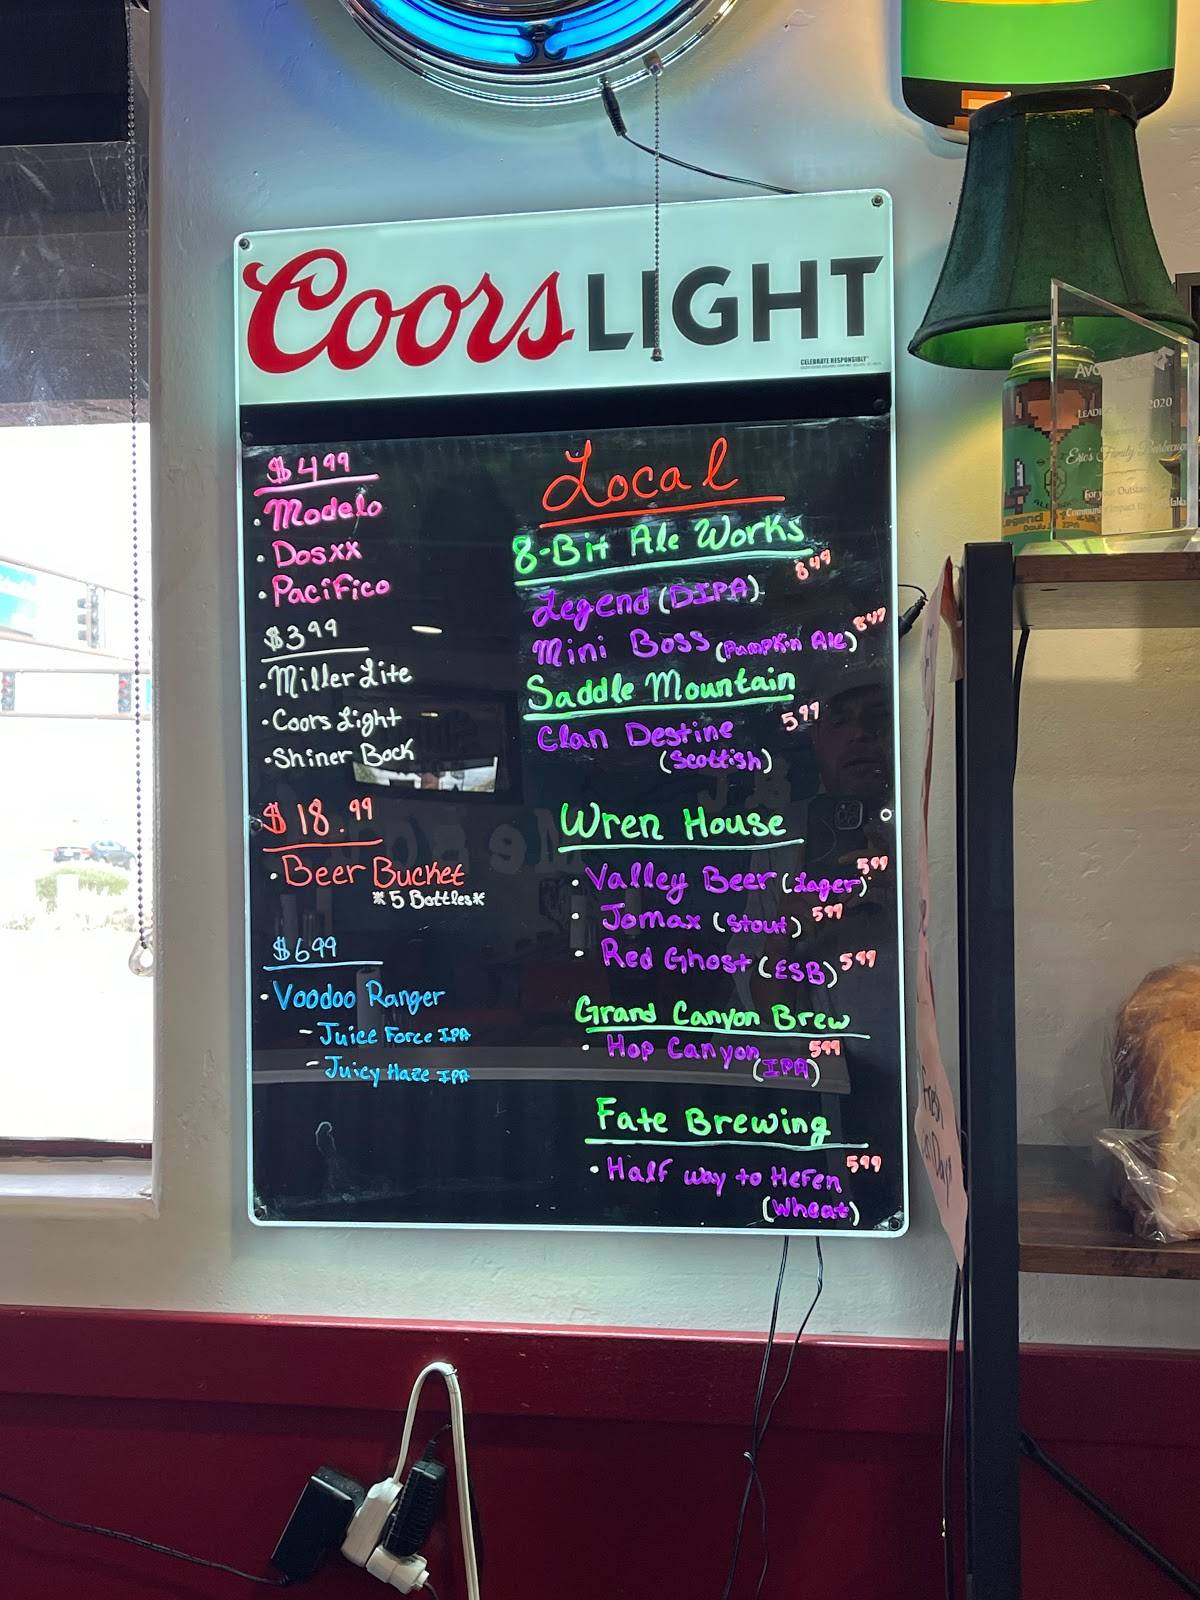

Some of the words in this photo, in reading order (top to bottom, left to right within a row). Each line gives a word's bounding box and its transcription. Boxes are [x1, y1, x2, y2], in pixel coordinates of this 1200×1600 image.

[243, 248, 575, 374] Coors
[587, 255, 884, 353] LIGHT
[541, 436, 740, 512] Local
[263, 494, 383, 532] Modelo
[512, 533, 610, 575] 8-Bit
[630, 526, 680, 557] Ale
[694, 513, 805, 551] Works
[532, 587, 651, 632] Legend
[658, 574, 761, 615] (DIPA)
[532, 633, 607, 668] Mini
[629, 628, 711, 659] Boss
[811, 629, 858, 653] Ale)
[267, 662, 353, 699] Miller
[358, 657, 414, 689] Lite
[525, 672, 635, 711] Saddle
[645, 665, 796, 702] Mountain
[271, 707, 333, 732] Coors
[336, 706, 403, 737] Light
[536, 722, 609, 752] Clan
[625, 719, 734, 748] Destine
[271, 747, 353, 769] Shiner
[658, 746, 774, 775] (Scottish)
[559, 801, 665, 841] Wren
[682, 805, 787, 841] House
[281, 853, 367, 887] Beer
[372, 856, 466, 889] Bucket
[584, 860, 690, 906] Valley
[702, 864, 778, 895] Beer
[599, 902, 702, 931] Jomax
[599, 937, 654, 970] Red
[663, 946, 753, 975] Ghost
[757, 955, 839, 989] (ESB)
[272, 980, 357, 1011] Voodoo
[365, 979, 447, 1016] Ranger
[574, 994, 658, 1025] Grand
[671, 999, 761, 1031] Canyon
[770, 1003, 851, 1031] Brew
[316, 1021, 379, 1047] Juice
[384, 1025, 433, 1045] Force
[437, 1027, 472, 1044] IPA
[606, 1033, 655, 1062] Hop
[666, 1036, 761, 1070] Canyon
[323, 1055, 381, 1089] Juicy
[386, 1063, 430, 1083] Haze
[437, 1068, 471, 1084] IPA
[752, 1057, 821, 1088] (IPA)
[595, 1096, 668, 1134] Fate
[684, 1106, 832, 1148] Brewing
[606, 1155, 674, 1184] Half
[735, 1167, 763, 1188] to
[761, 1195, 861, 1227] (Wheat)
